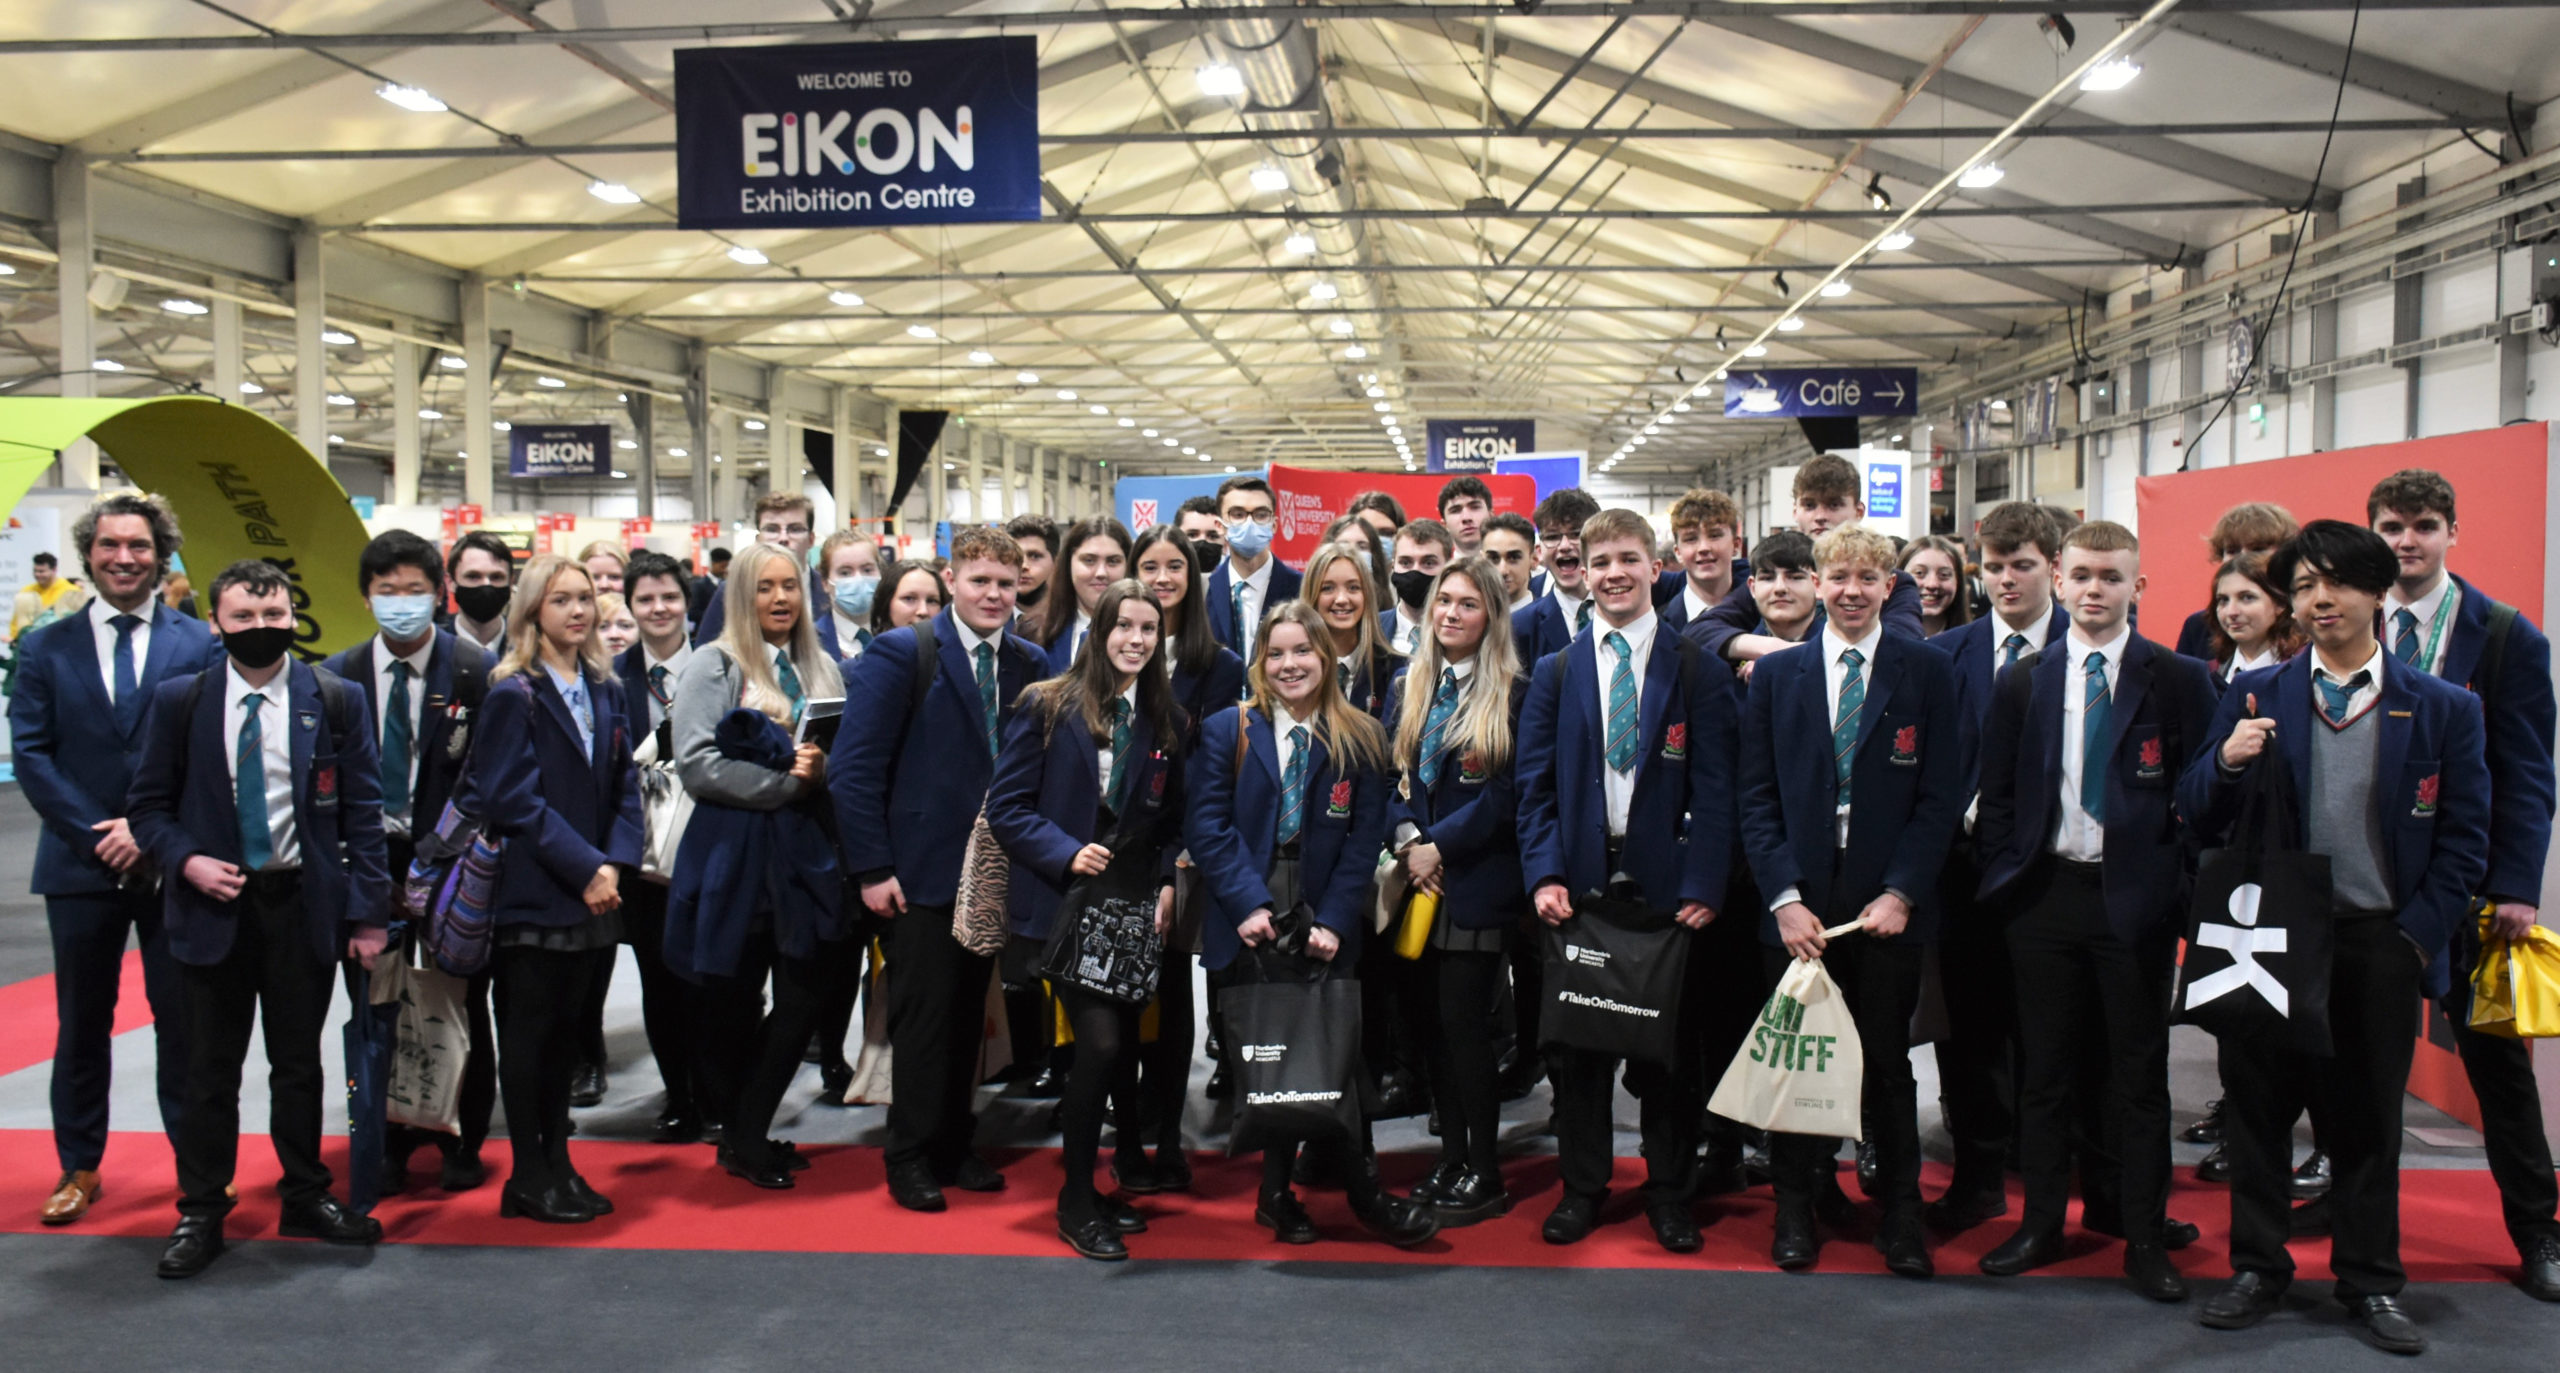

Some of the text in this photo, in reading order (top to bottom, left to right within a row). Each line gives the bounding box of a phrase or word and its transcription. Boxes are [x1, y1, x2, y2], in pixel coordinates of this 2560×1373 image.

[797, 70, 912, 90] WELCOME TO
[741, 105, 975, 178] EIKON
[741, 183, 975, 214] Exhibition Centre
[526, 442, 594, 463] EIKON
[1445, 437, 1516, 459] EIKON
[198, 461, 288, 548] PATH
[1295, 494, 1322, 509] QUEEN'S
[1296, 509, 1336, 524] UNIVERSITY
[1297, 522, 1321, 536] BELFAST
[1559, 991, 1660, 1018] #TakeOnTomorrow
[1761, 990, 1805, 1034] UNI
[1750, 1026, 1836, 1072] STUFF
